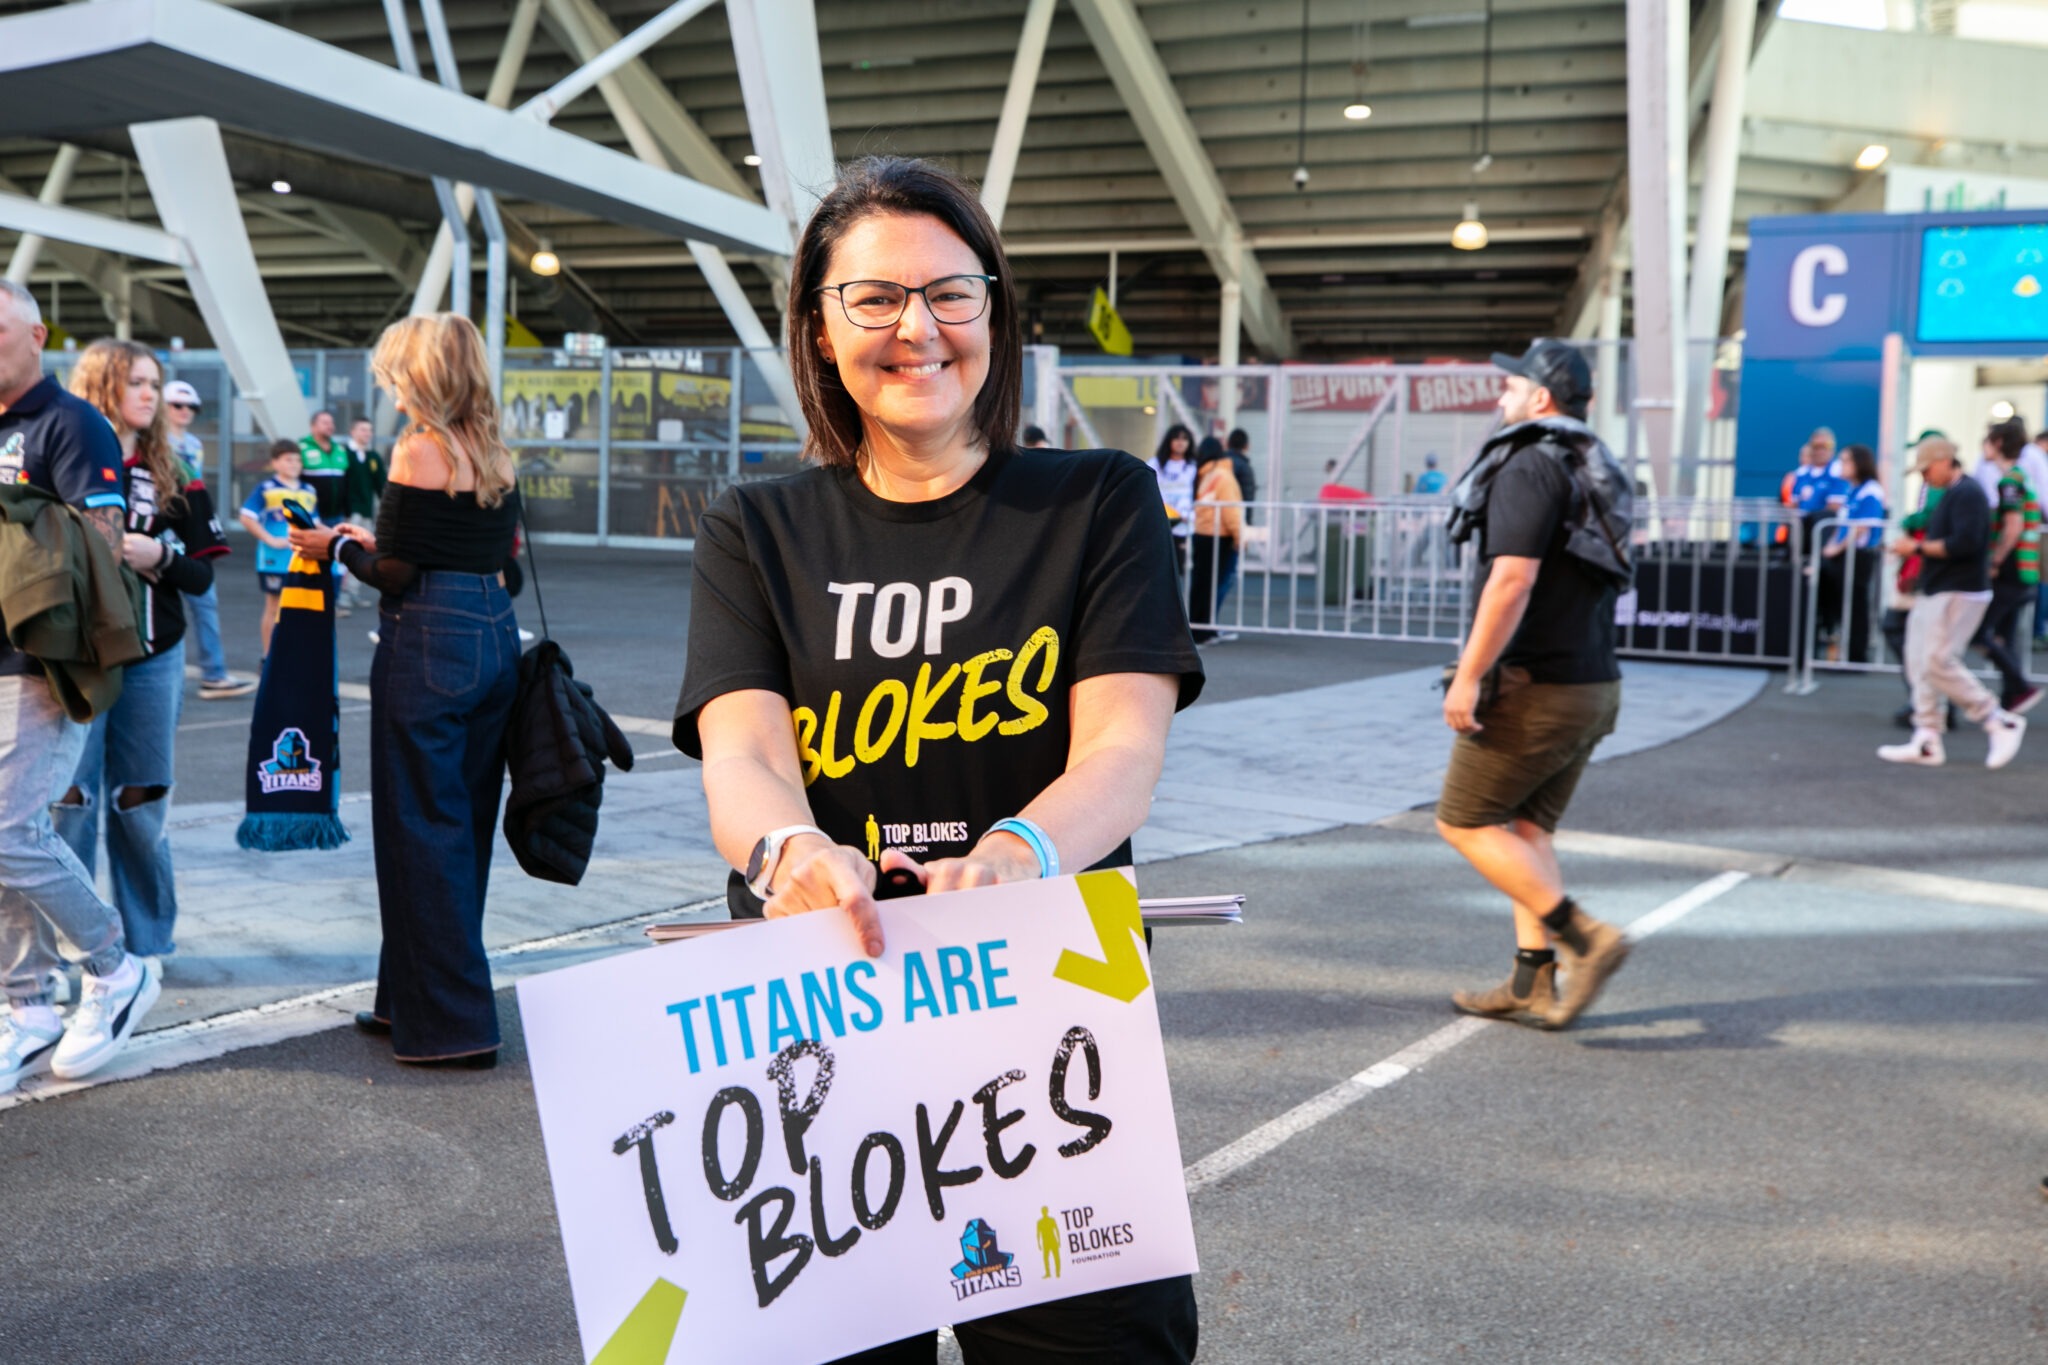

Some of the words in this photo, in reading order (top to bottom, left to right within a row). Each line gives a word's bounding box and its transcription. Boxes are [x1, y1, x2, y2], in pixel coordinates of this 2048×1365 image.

[1789, 244, 1848, 327] C
[1416, 373, 1506, 411] BRISKE
[827, 576, 973, 661] TOP
[792, 625, 1060, 788] BLOKES
[260, 771, 321, 792] TITANS
[882, 824, 911, 844] TOP
[912, 821, 968, 844] BLOKES
[665, 959, 884, 1074] TITANS
[903, 939, 1018, 1023] ARE
[612, 1038, 837, 1256] TOP
[734, 1025, 1113, 1308] BLOKES
[1060, 1206, 1094, 1231] TOP
[1067, 1222, 1134, 1254] BLOKES
[1071, 1250, 1121, 1264] FOUNDATION
[950, 1265, 1022, 1301] TITANS
